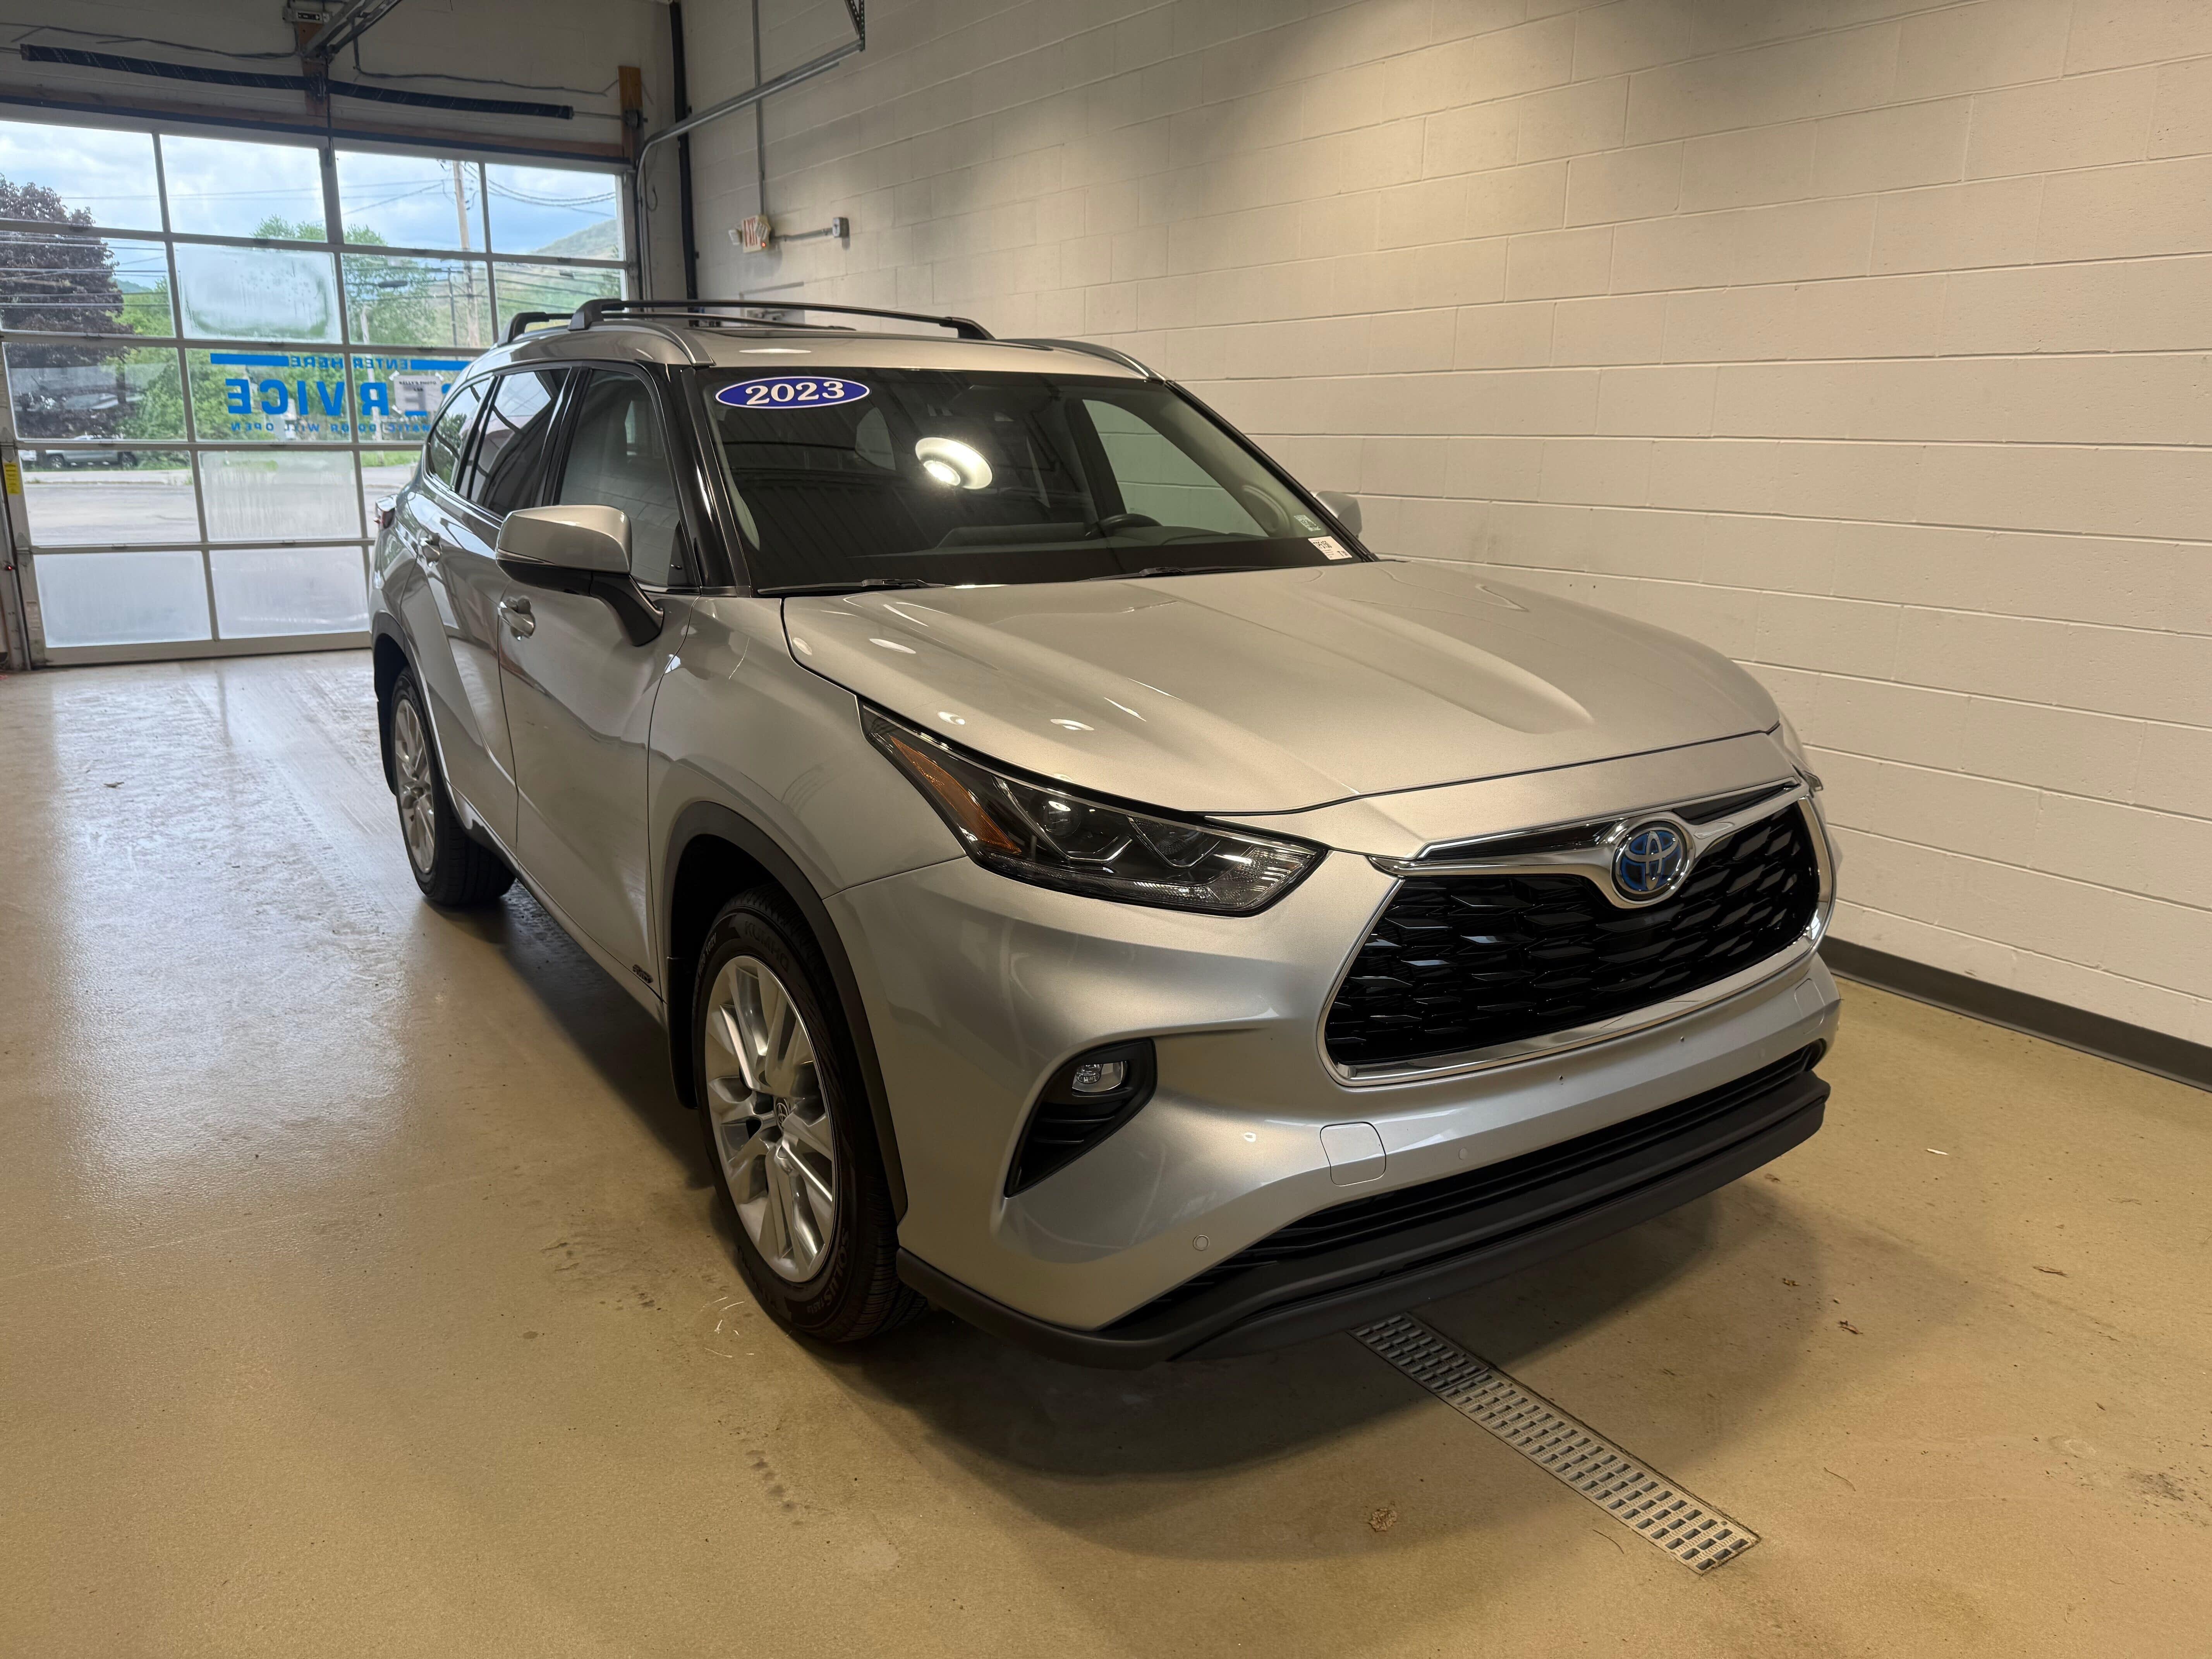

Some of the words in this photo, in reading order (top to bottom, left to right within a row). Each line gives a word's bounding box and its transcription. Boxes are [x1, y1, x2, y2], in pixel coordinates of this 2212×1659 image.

[745, 381, 845, 405] 2023
[744, 920, 789, 973] KUMHO
[823, 1226, 850, 1307] SOLUS
